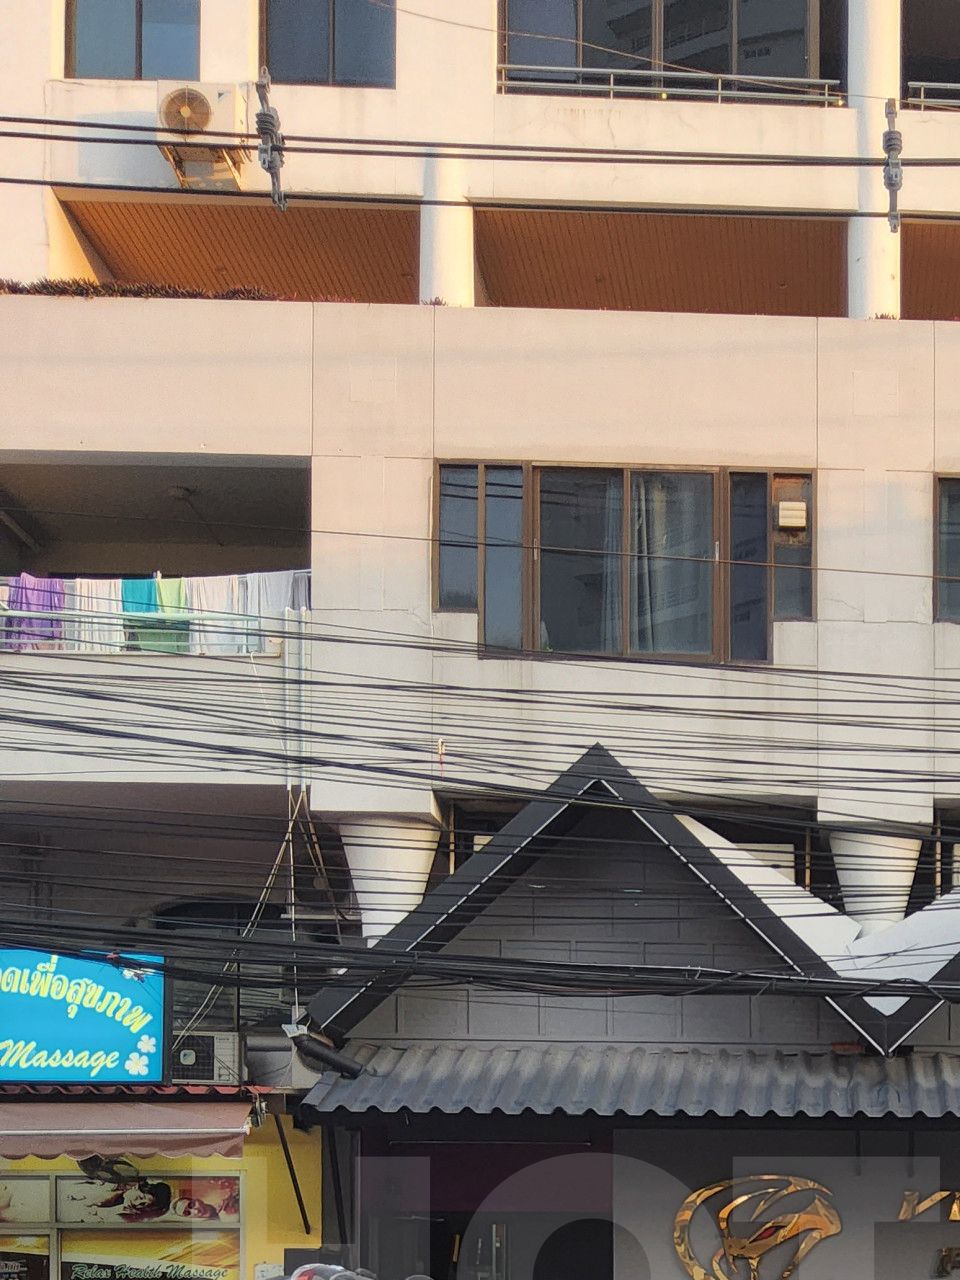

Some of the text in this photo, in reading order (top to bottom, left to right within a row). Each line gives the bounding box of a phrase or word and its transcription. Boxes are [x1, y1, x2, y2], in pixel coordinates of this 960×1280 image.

[0, 954, 153, 1034] ดเพื่อสุขภาพ
[0, 1038, 120, 1077] Massage
[71, 1264, 112, 1280] Relax
[113, 1264, 162, 1279] Health
